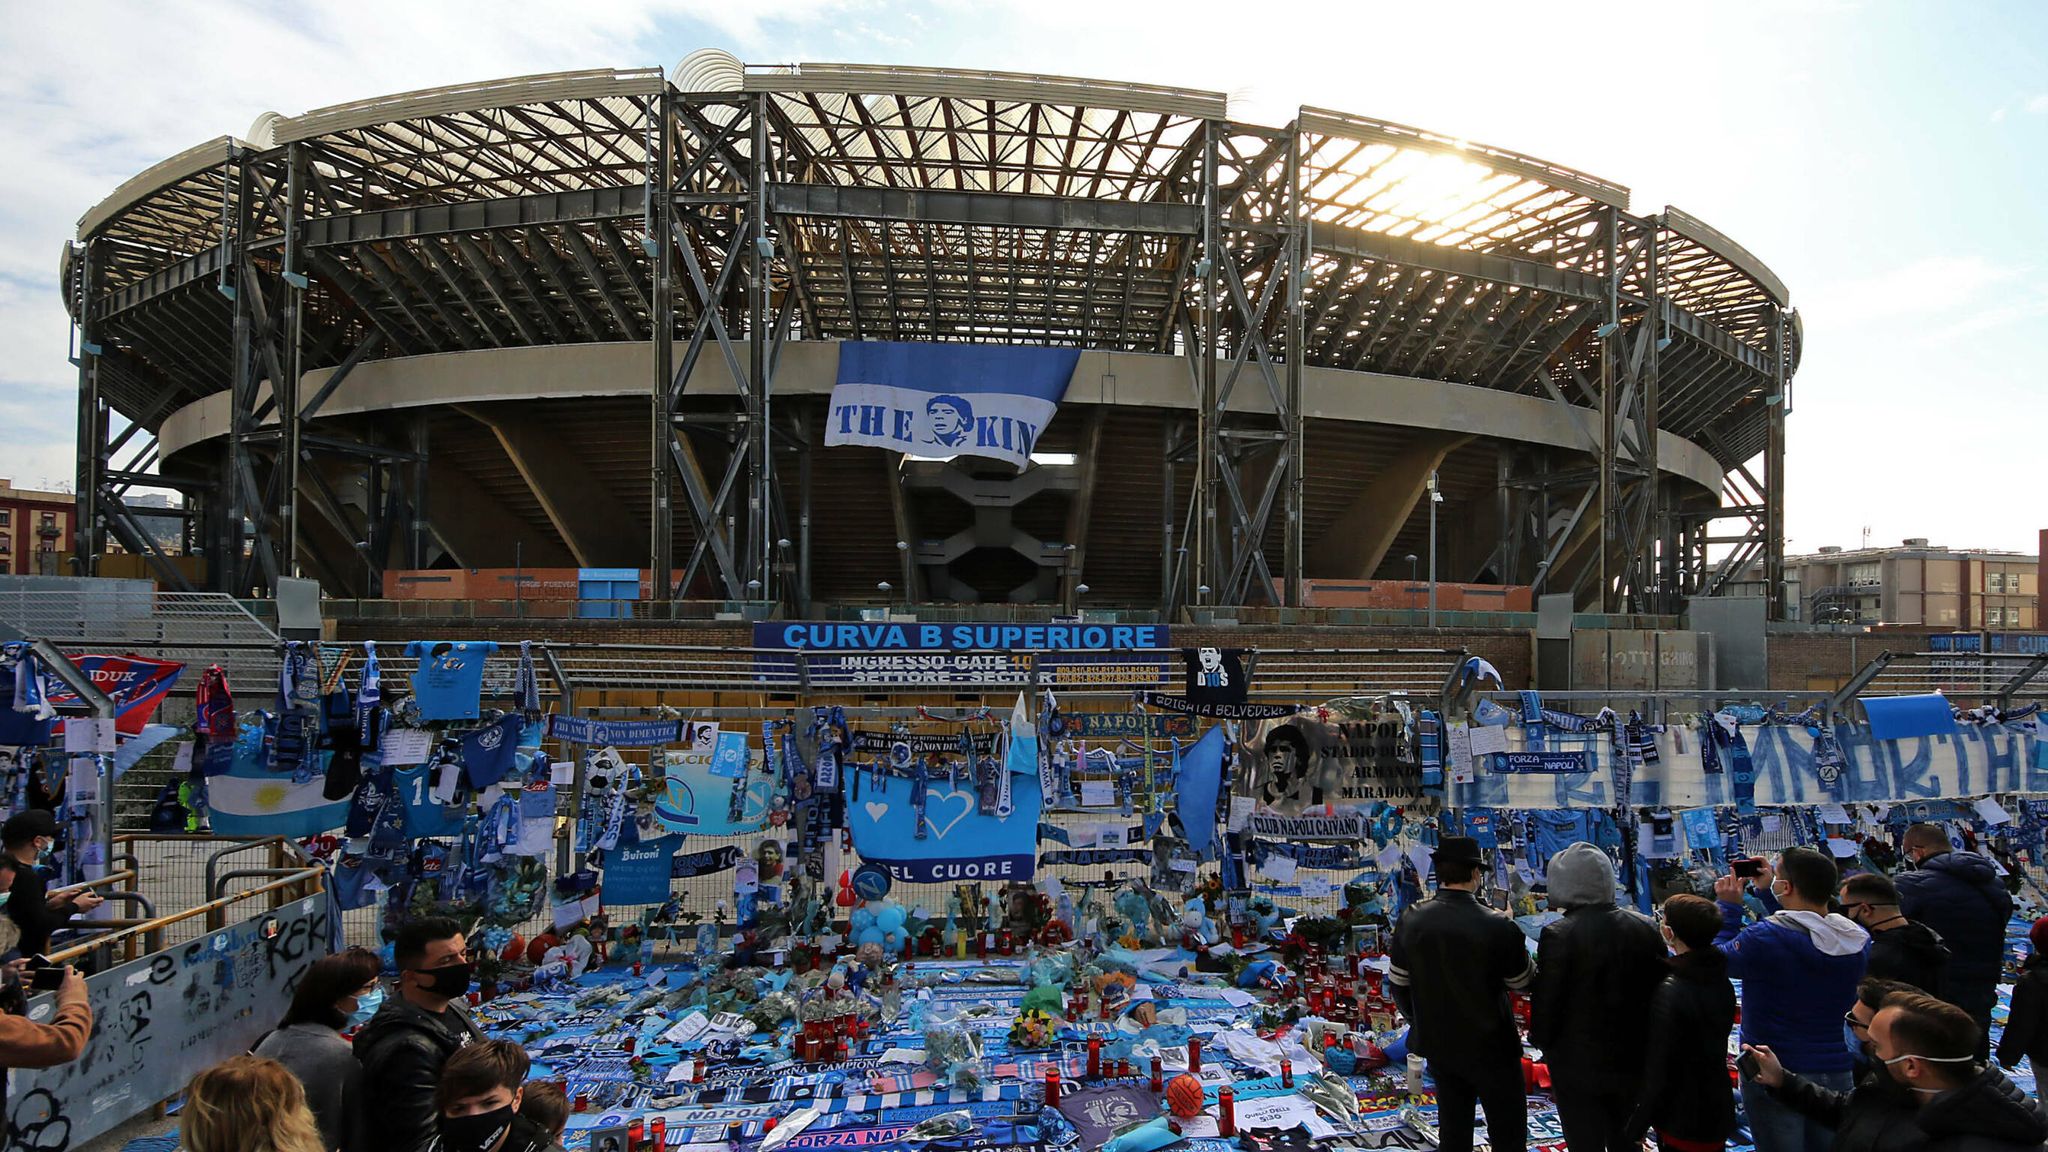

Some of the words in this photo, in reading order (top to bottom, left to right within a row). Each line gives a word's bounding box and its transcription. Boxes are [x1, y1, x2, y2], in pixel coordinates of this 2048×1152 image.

[835, 404, 914, 443] THE
[783, 624, 909, 649] CURVA
[920, 625, 943, 648] B
[952, 625, 1156, 649] SUPERIORE
[1931, 636, 1951, 650] CURV
[954, 655, 1007, 670] GATE
[852, 671, 950, 683] SETTORE
[1196, 672, 1229, 688] D10S
[609, 728, 626, 739] NON
[629, 726, 677, 739] DIMENTICA
[1508, 754, 1540, 764] FORZA
[1544, 761, 1575, 770] NAPOLI
[1254, 817, 1280, 834] CLUB
[1280, 818, 1315, 836] NAPOLI
[1315, 817, 1359, 835] CAIVANO
[889, 864, 914, 880] EL
[931, 860, 1013, 879] CUORE
[686, 1107, 764, 1121] NAPOL
[785, 1131, 857, 1149] FORZA
[865, 1129, 909, 1145] NAP
